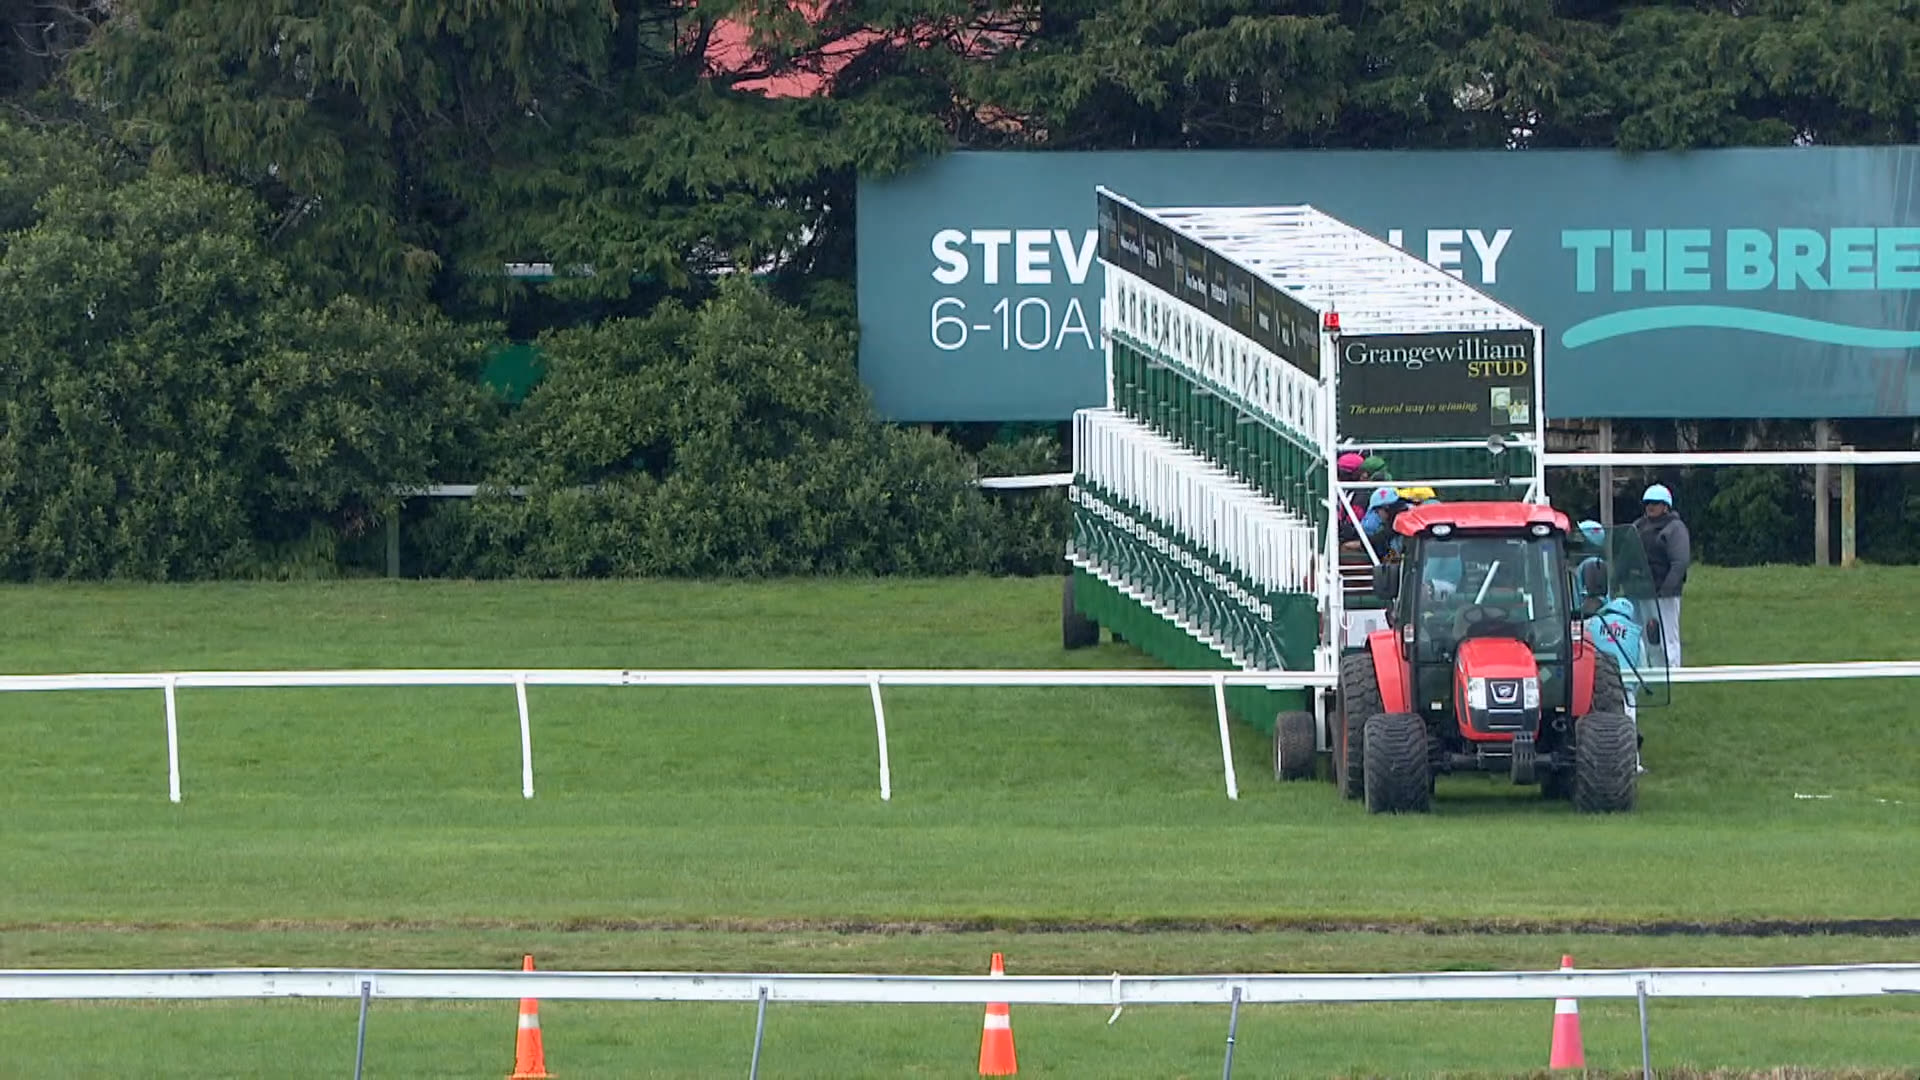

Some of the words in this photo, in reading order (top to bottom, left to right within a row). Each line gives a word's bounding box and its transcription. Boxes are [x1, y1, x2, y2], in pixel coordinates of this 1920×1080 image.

[1388, 229, 1513, 284] EY
[1561, 228, 1712, 292] THE
[1726, 227, 1920, 291] BREE
[931, 297, 1105, 350] 6-10A
[1345, 337, 1525, 370] Grangewilliam
[1467, 361, 1528, 378] STUD
[1349, 405, 1367, 415] The
[1369, 403, 1404, 414] natural
[1405, 405, 1424, 415] way
[1425, 403, 1436, 413] to
